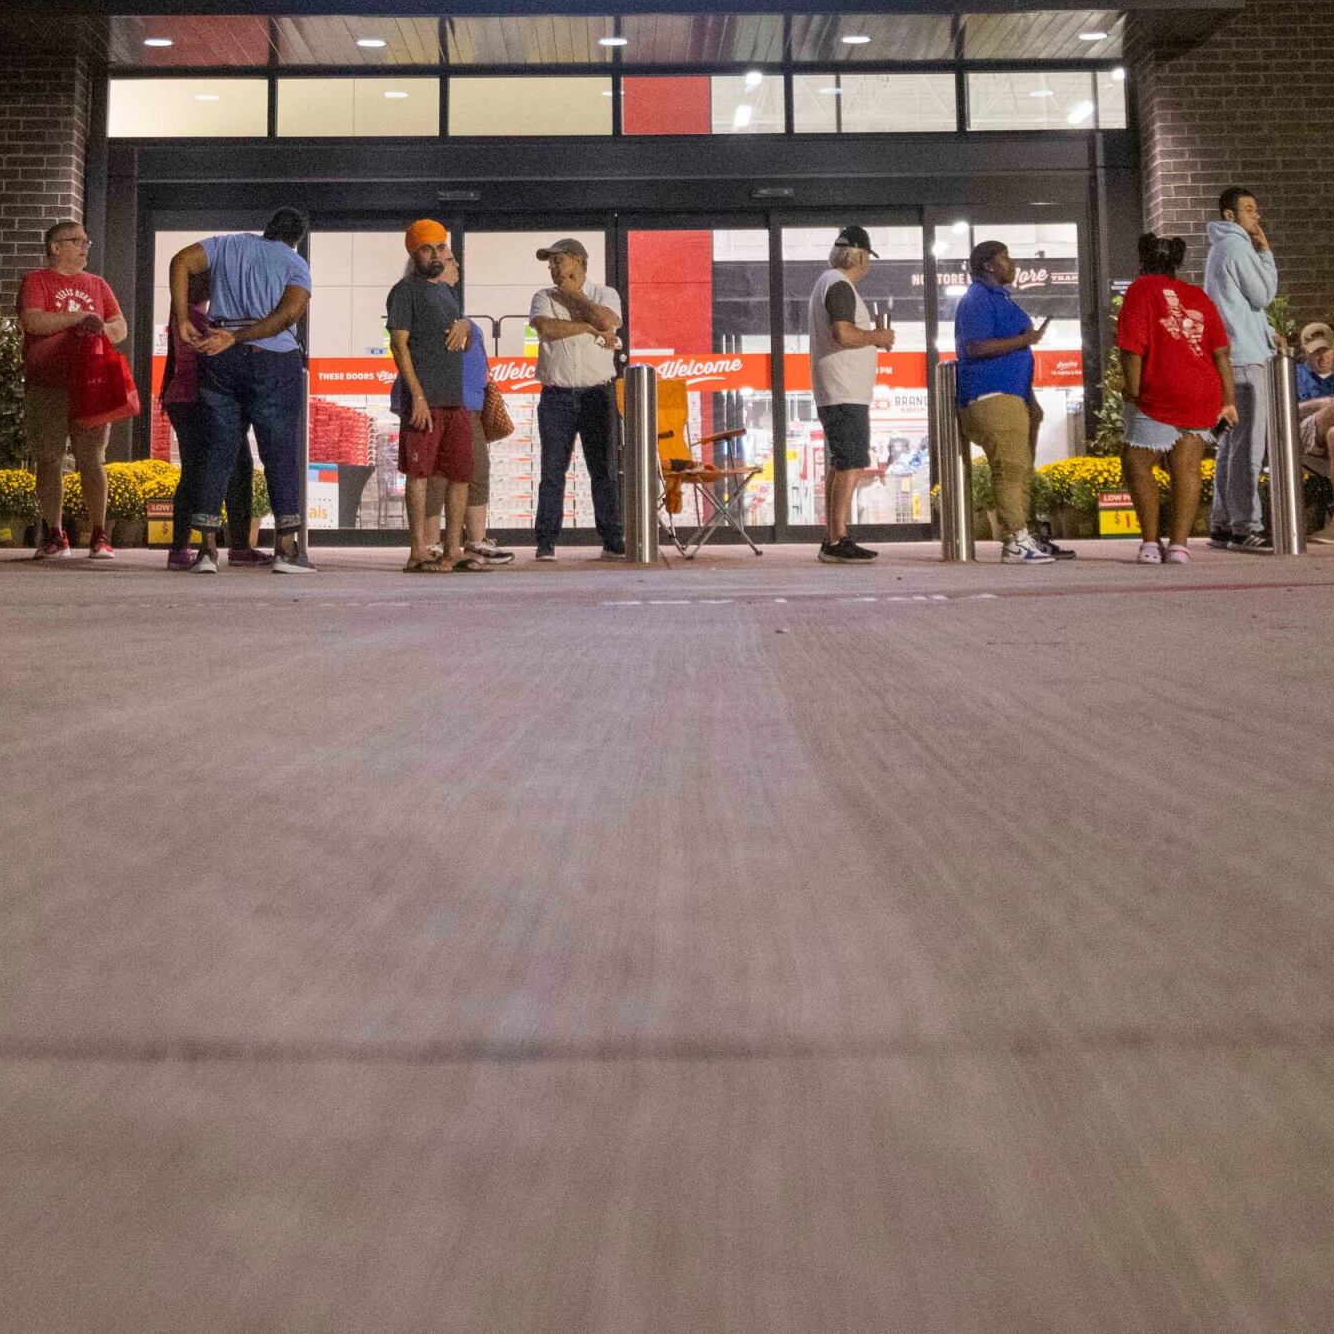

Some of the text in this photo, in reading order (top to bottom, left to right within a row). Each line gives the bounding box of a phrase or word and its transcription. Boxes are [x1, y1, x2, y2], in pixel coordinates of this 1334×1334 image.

[938, 273, 964, 284] TORE
[489, 362, 535, 381] Welc
[657, 358, 743, 379] Welcome
[318, 372, 345, 380] THESE
[346, 372, 374, 380] DOORS
[152, 504, 170, 512] LOW
[308, 505, 328, 519] als
